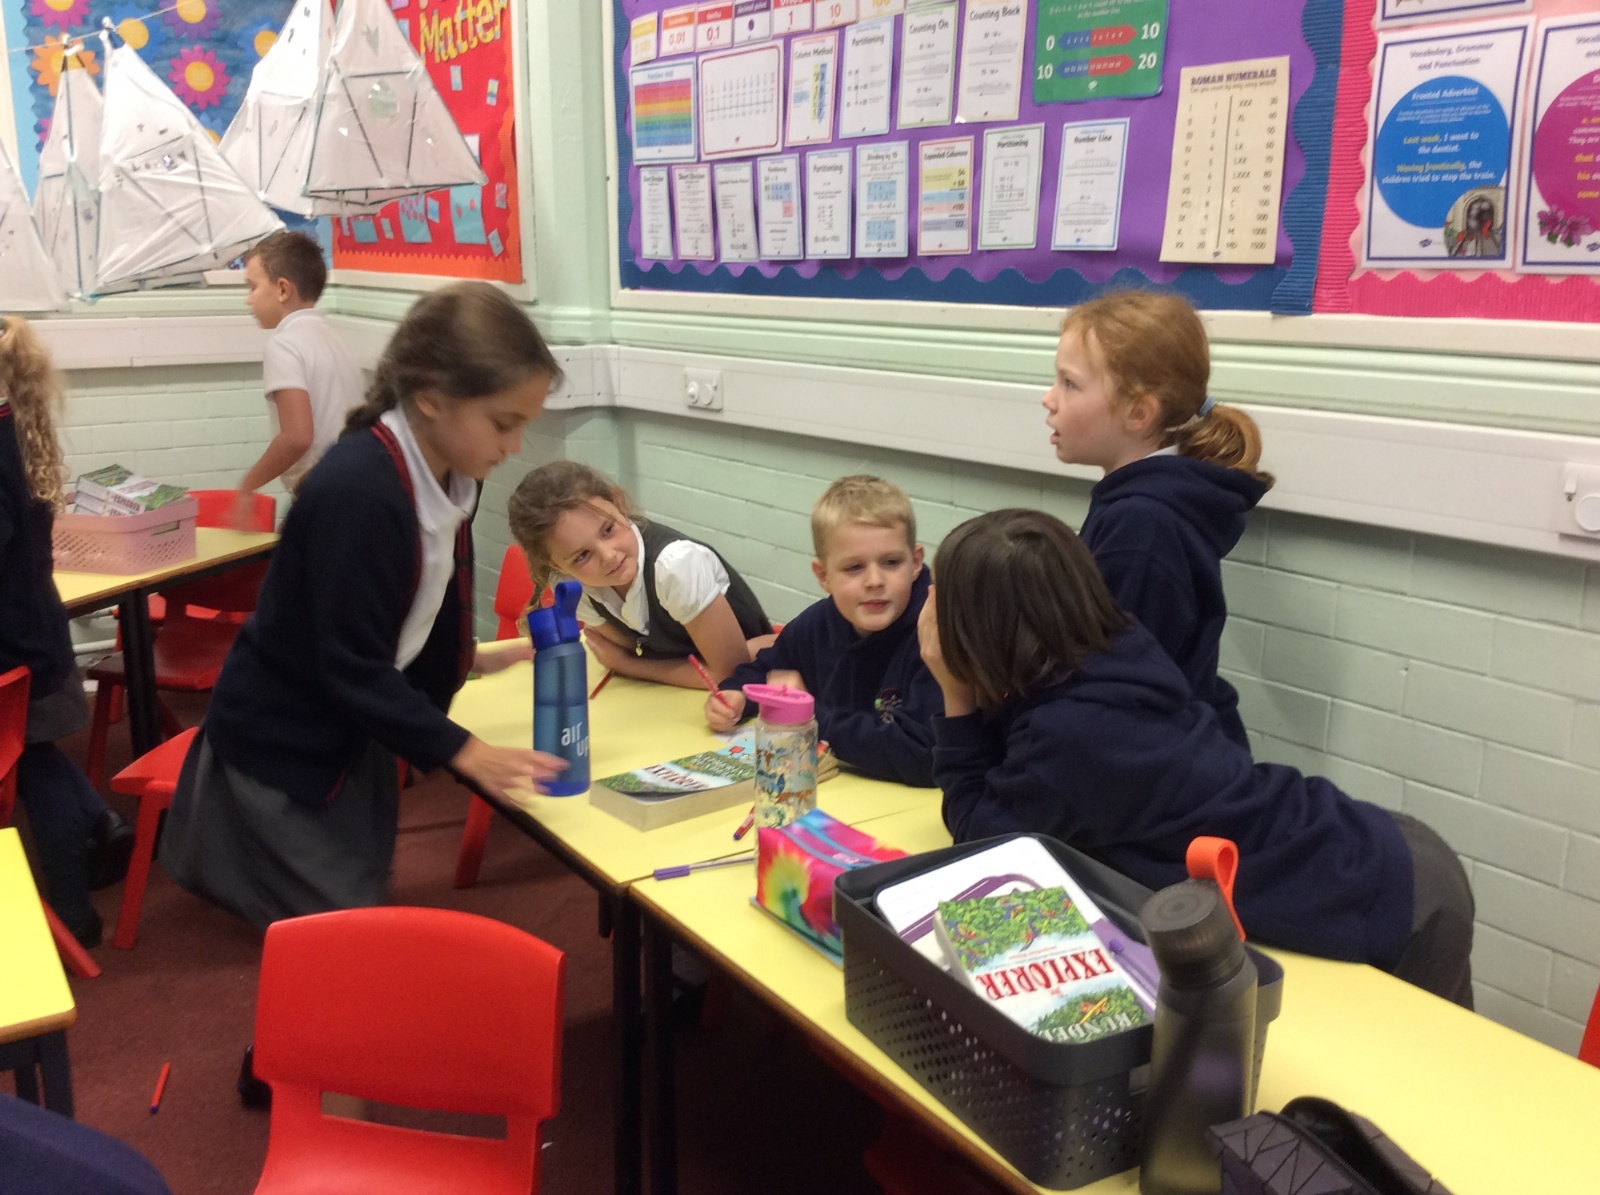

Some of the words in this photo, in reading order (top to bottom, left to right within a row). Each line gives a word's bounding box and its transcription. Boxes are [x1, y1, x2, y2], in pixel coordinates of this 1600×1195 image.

[830, 4, 841, 18] 10
[969, 10, 999, 21] Counting
[1002, 5, 1020, 17] Back
[707, 26, 720, 42] 0.1
[909, 23, 936, 35] Counting
[938, 19, 949, 30] On
[1141, 21, 1160, 40] 10
[669, 31, 686, 46] 0.01
[852, 34, 884, 47] Partitioning
[1046, 35, 1055, 51] 0
[1138, 52, 1157, 70] 20
[1037, 63, 1053, 80] 10
[1191, 74, 1223, 86] ROMAN
[1226, 68, 1277, 82] NUMERALS
[997, 140, 1028, 149] Partitioning
[813, 164, 843, 174] Partitioning
[561, 721, 582, 747] air
[975, 948, 1115, 1000] EXPLORER
